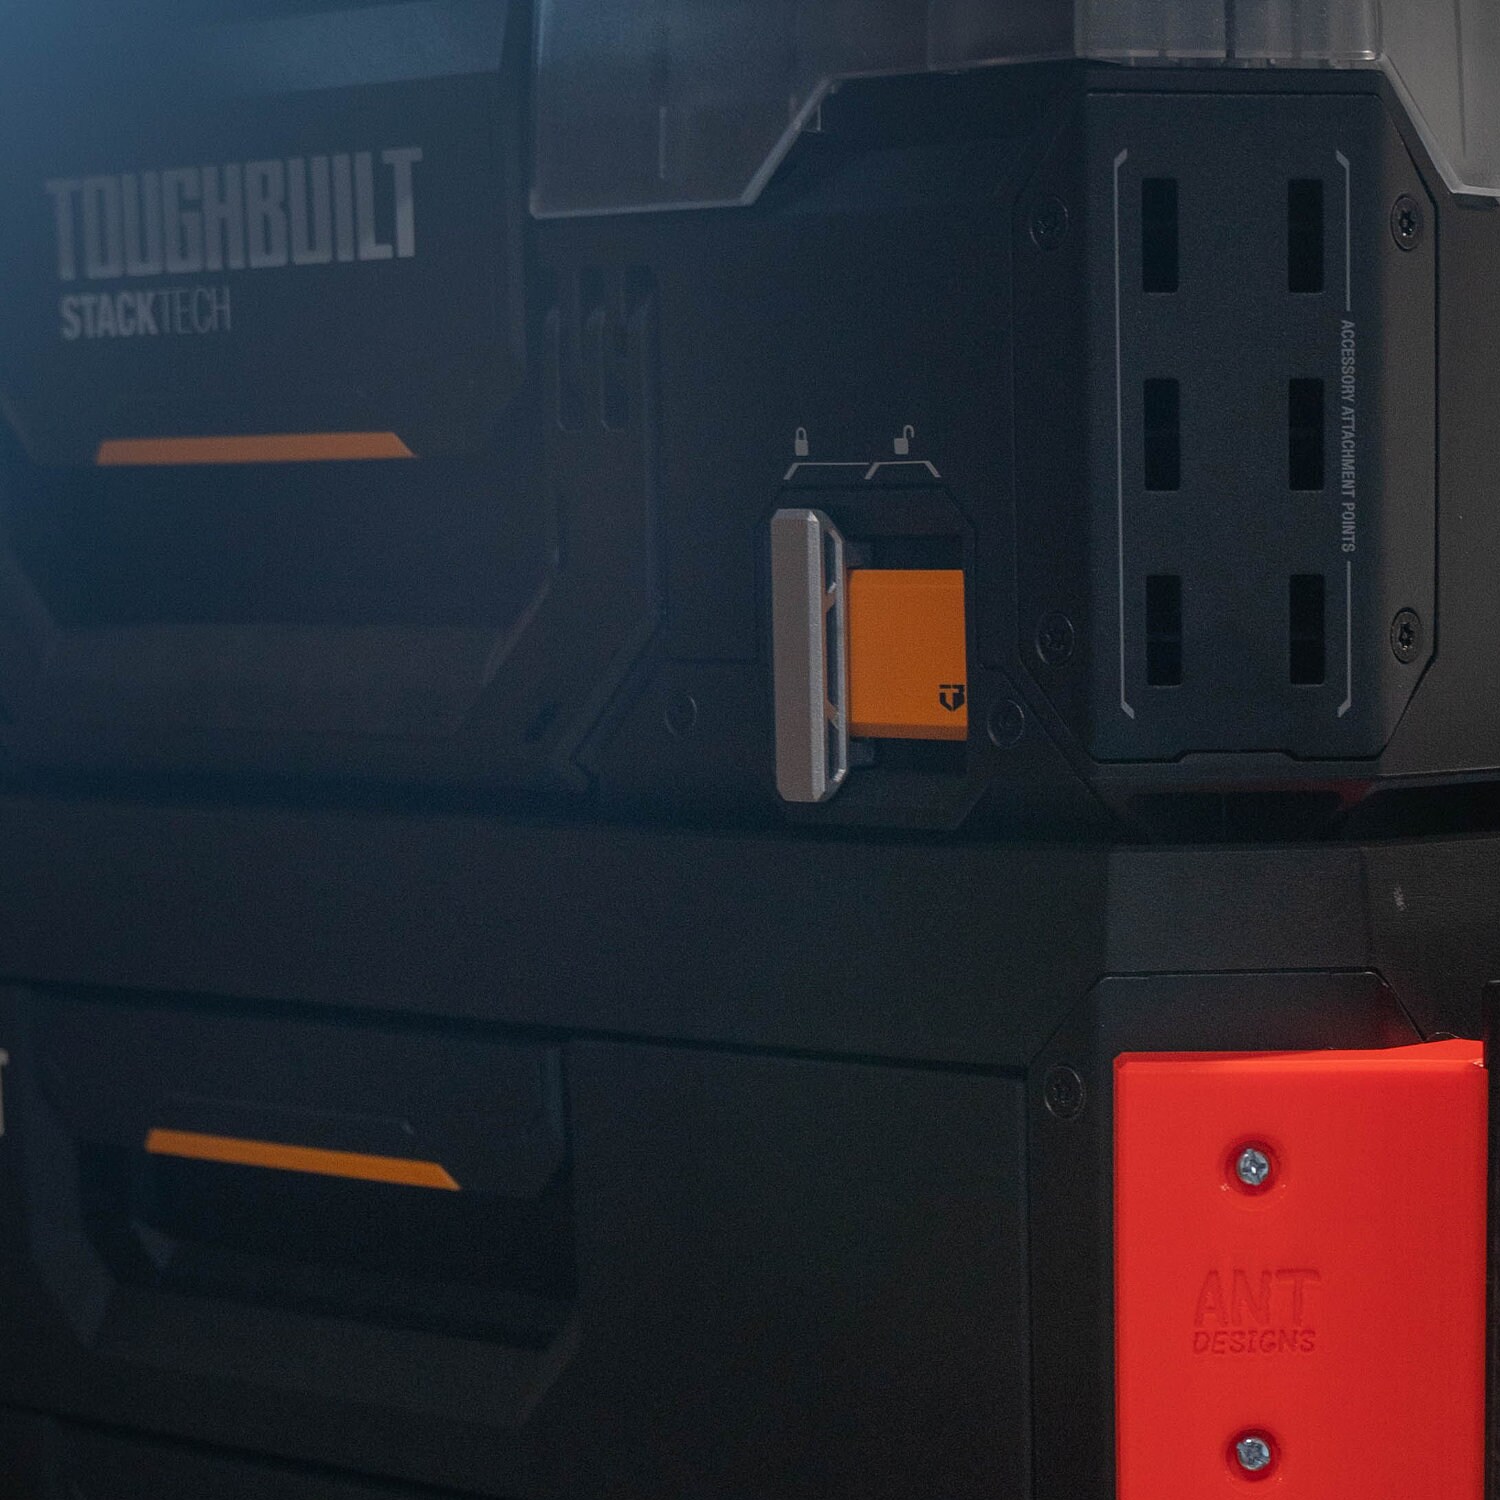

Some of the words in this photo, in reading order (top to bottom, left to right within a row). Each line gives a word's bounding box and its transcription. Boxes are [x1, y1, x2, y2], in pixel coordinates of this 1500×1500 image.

[46, 148, 422, 281] TOUGHBUILT
[1341, 319, 1355, 401] ACCESSORY
[1341, 406, 1355, 498] ATTACHMENT
[1341, 501, 1355, 552] POINTS
[1194, 1268, 1321, 1326] ANT
[1193, 1328, 1317, 1355] DESIGNS
